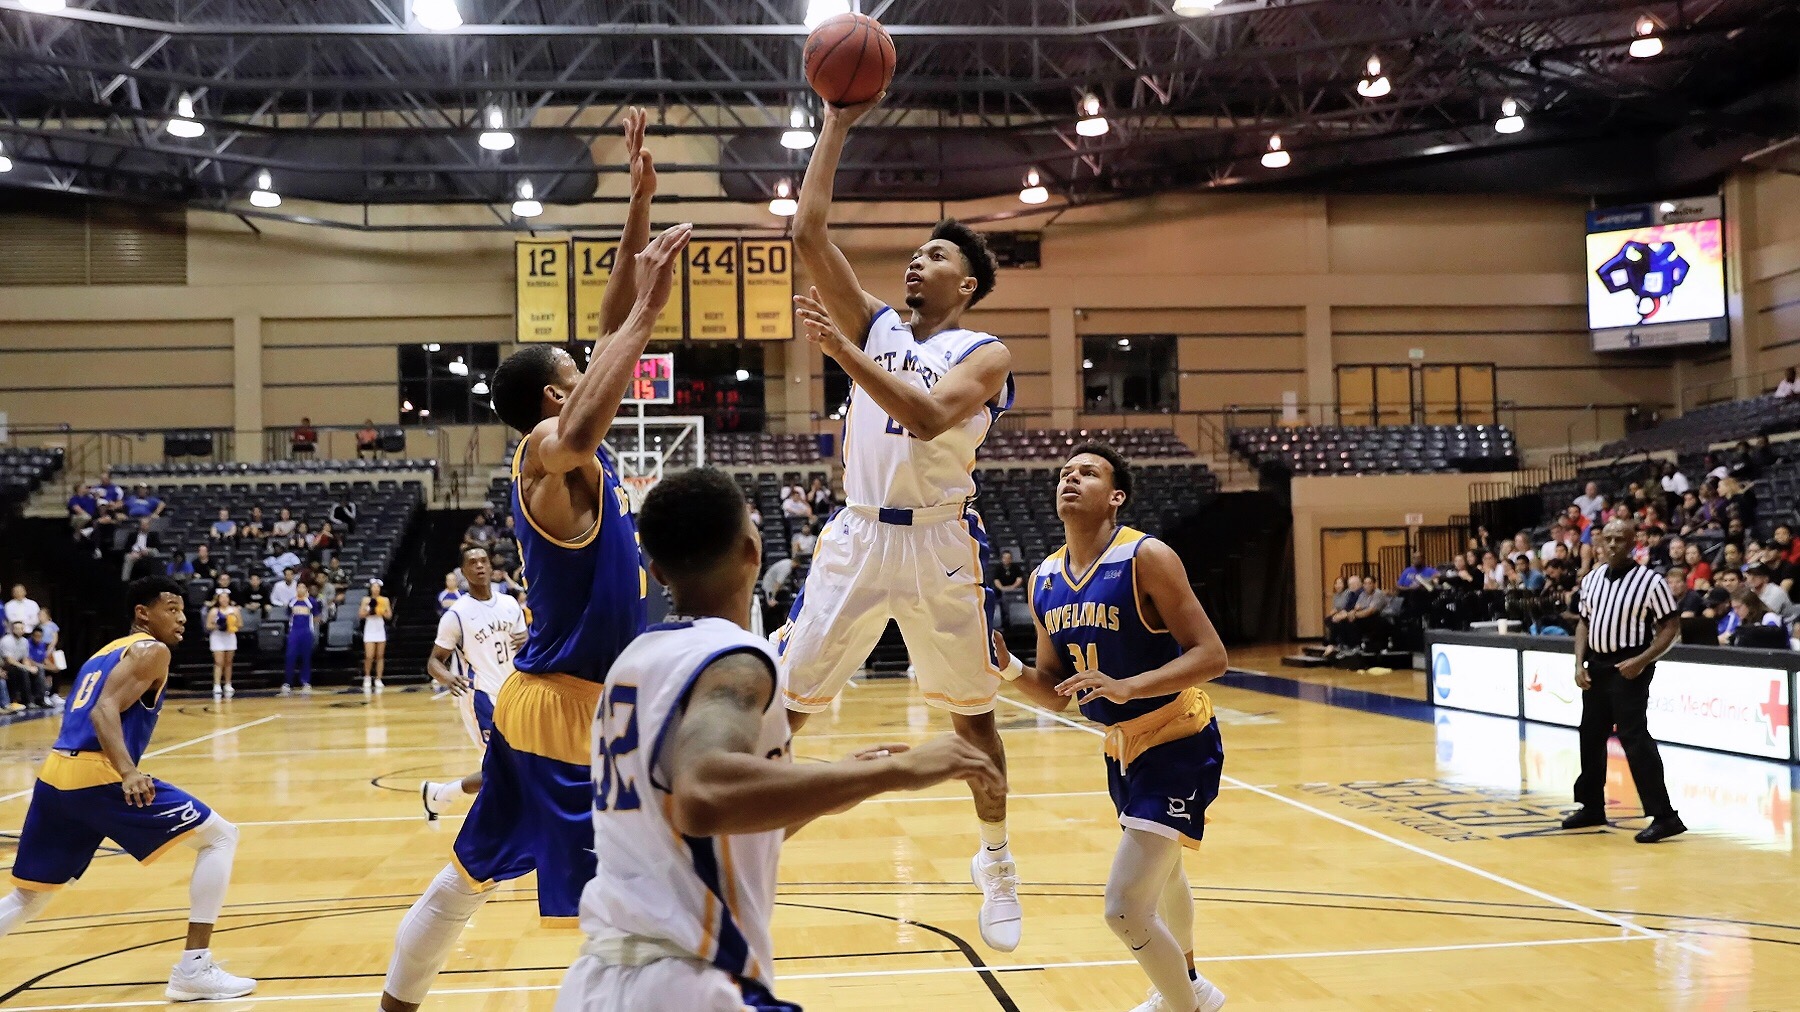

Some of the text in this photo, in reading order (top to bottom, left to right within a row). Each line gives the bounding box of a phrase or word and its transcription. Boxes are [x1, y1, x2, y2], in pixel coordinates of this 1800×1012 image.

[528, 248, 556, 276] 12
[582, 247, 615, 275] 14
[691, 246, 734, 274] 44
[747, 246, 786, 274] 50
[494, 641, 509, 665] 21
[1648, 696, 1675, 713] exas
